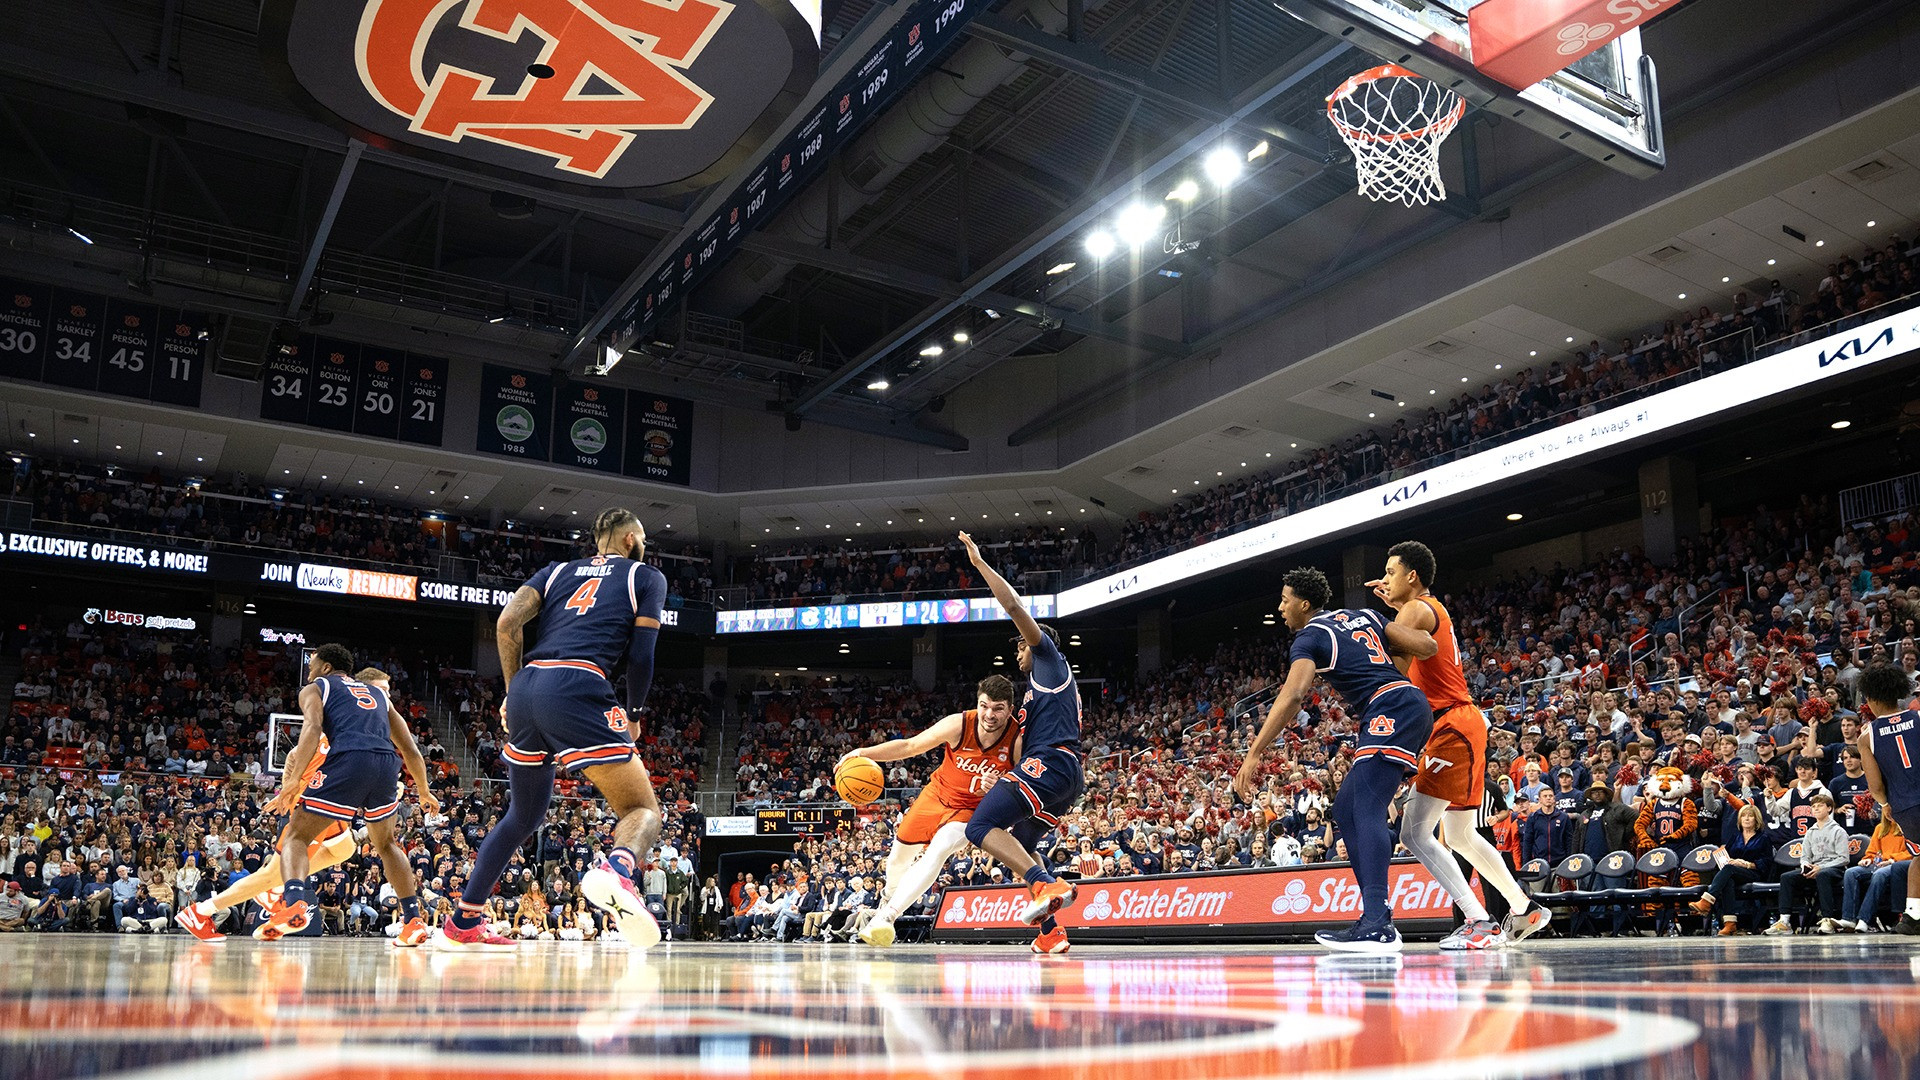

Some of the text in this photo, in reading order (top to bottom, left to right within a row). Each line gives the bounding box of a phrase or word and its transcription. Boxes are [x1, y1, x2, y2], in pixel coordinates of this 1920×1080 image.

[862, 69, 888, 105] 1989
[800, 134, 822, 165] 1988
[746, 188, 767, 219] 1987
[0, 313, 42, 328] MITCHELL
[56, 323, 96, 338] BARKLEY
[0, 328, 37, 354] 30
[112, 333, 148, 347] PERSON
[55, 337, 91, 363] 34
[163, 343, 199, 356] PERSON
[109, 347, 145, 372] 45
[169, 356, 191, 381] 11
[269, 362, 309, 375] JACKSON
[319, 371, 351, 383] BOLTON
[371, 379, 389, 389] ORR
[270, 374, 303, 399] 34
[318, 383, 348, 407] 25
[413, 387, 437, 398] JONES
[500, 386, 535, 398] WOMEN'S
[363, 391, 394, 415] 50
[497, 392, 537, 405] BASKETBALL
[573, 400, 607, 411] WOMEN'S
[410, 399, 435, 422] 21
[570, 406, 609, 418] BASKETBALL
[644, 412, 676, 423] WOMEN'S
[641, 418, 678, 429] BASKETBALL
[1501, 449, 1535, 467] Where
[1566, 433, 1585, 446] Are
[1590, 418, 1631, 438] Always
[1636, 410, 1649, 423] #1
[502, 443, 525, 454] 1988
[576, 455, 599, 466] 1989
[647, 466, 668, 477] 1990
[1644, 490, 1667, 508] 112
[9, 533, 88, 559] EXCLUSIVE
[91, 542, 147, 569] OFFERS,
[149, 550, 161, 567] &
[163, 551, 209, 573] MORE!
[261, 562, 678, 626] JOIN Newk's REWARDS SCORE FREE FOO RE!
[565, 577, 603, 616] 4
[219, 601, 239, 613] 116
[920, 601, 939, 624] 24
[105, 609, 143, 625] Bens
[824, 606, 842, 629] 34
[915, 643, 933, 654] 114
[346, 686, 378, 711] 5
[1879, 719, 1915, 737] HOLLOWAY
[1895, 734, 1912, 769] 1
[955, 756, 1005, 777] Hokies
[758, 810, 786, 819] AUBURN
[793, 811, 821, 822] 19:11
[763, 820, 851, 832] 34 24
[808, 824, 814, 833] 2
[1797, 818, 1808, 836] 5
[966, 895, 1034, 923] StateFa
